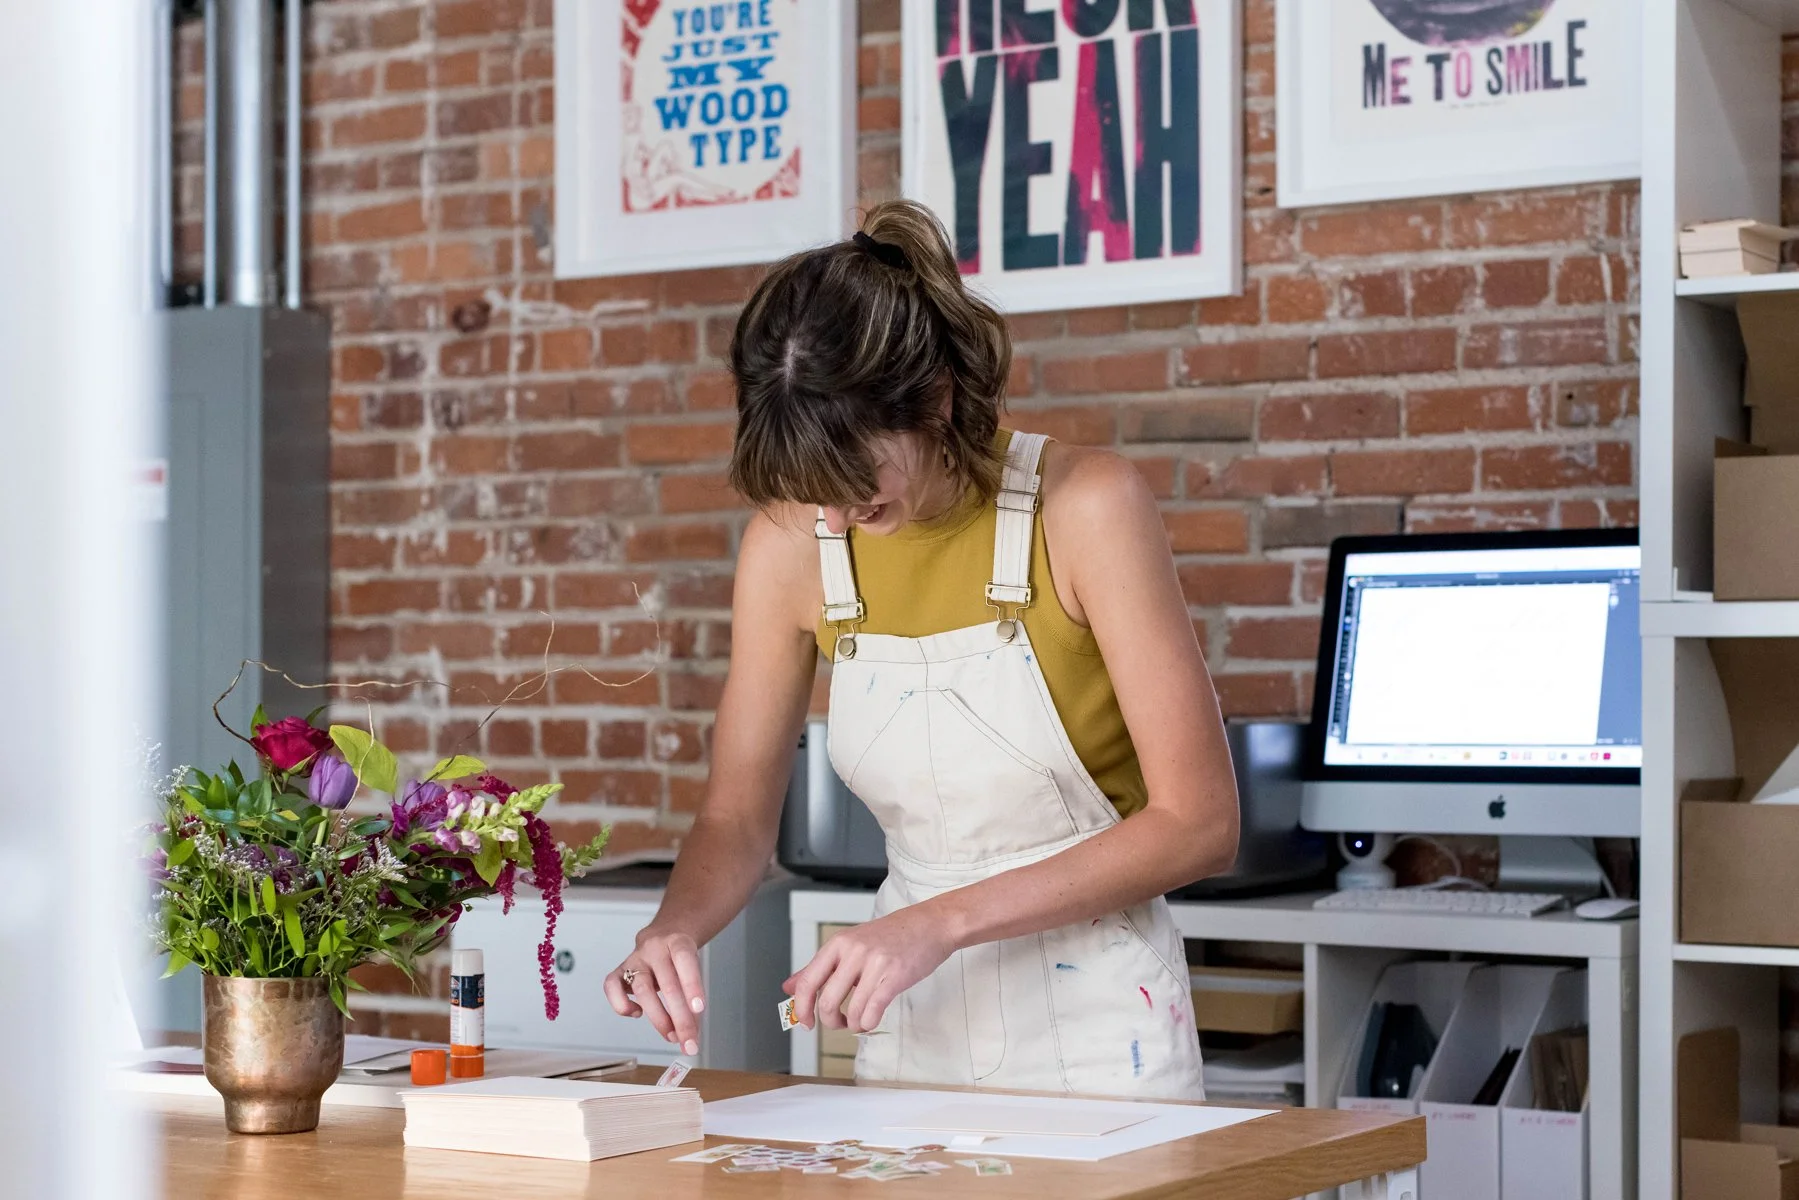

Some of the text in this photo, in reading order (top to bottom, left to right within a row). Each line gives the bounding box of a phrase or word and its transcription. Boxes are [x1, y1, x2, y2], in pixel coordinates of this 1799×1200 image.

[672, 0, 773, 37] YOU'RE
[661, 32, 780, 62] JUST
[1426, 51, 1473, 102] TO
[1486, 19, 1587, 96] SMILE
[667, 56, 775, 90] MY
[653, 83, 790, 131] WOOD
[689, 125, 782, 168] TYPE
[938, 27, 1201, 276] YEAH
